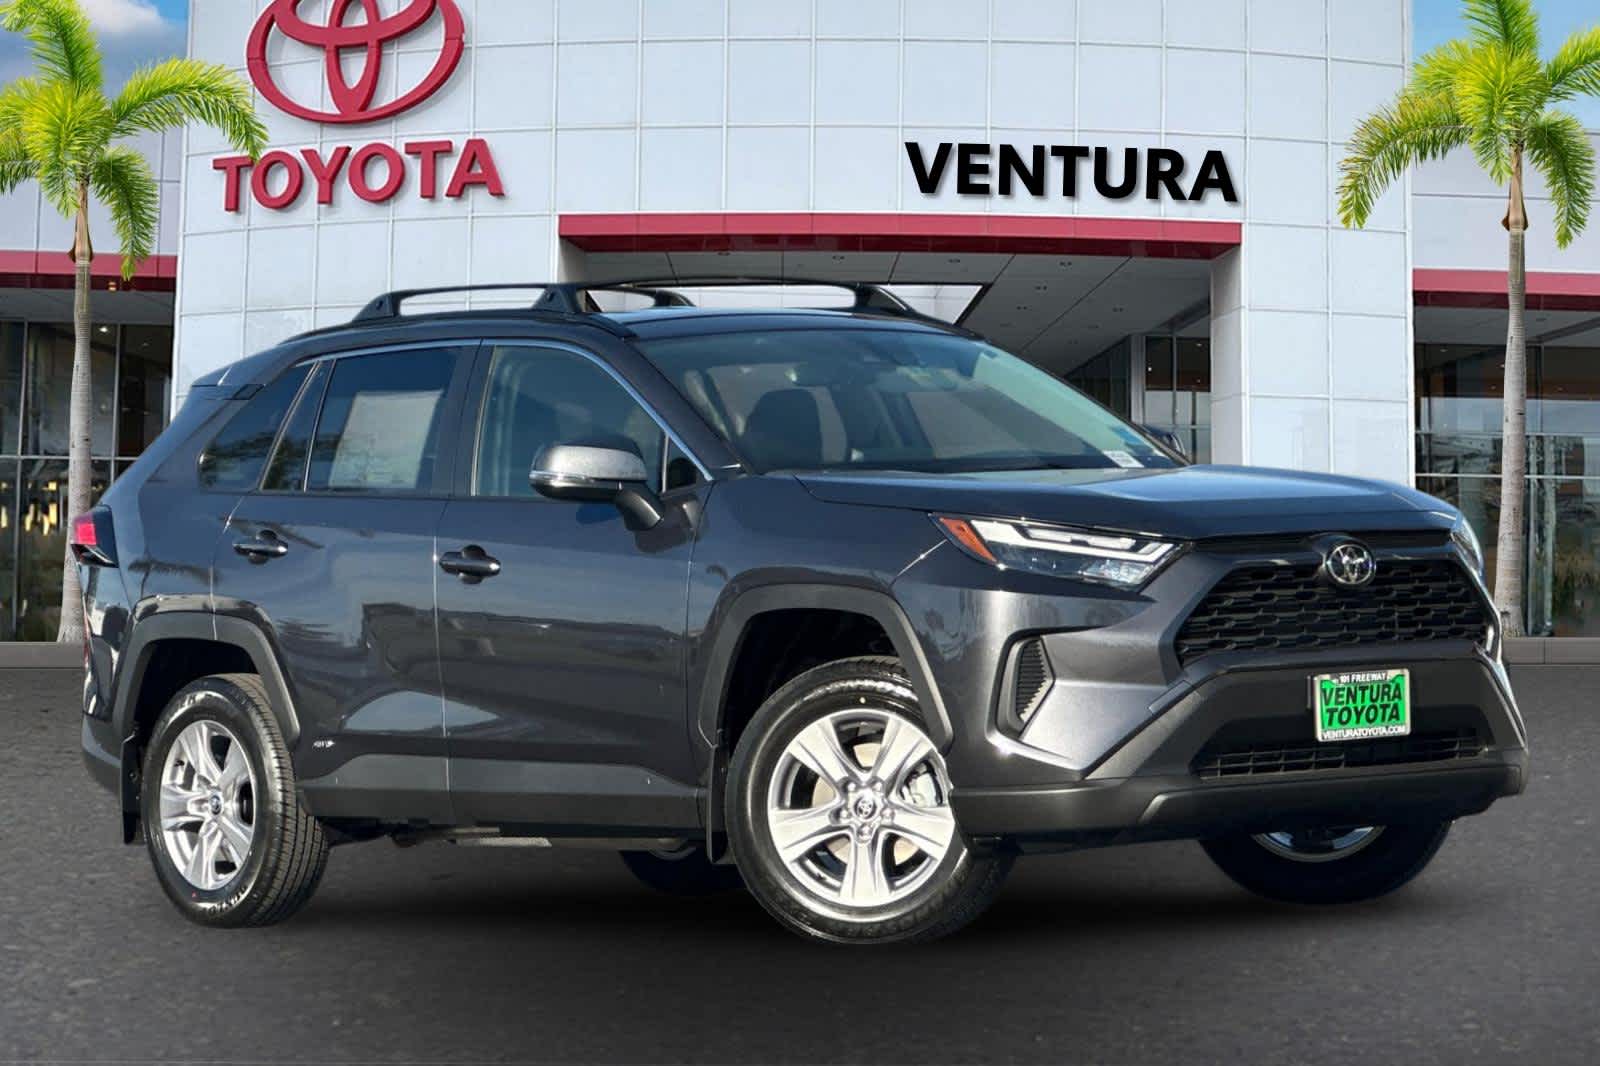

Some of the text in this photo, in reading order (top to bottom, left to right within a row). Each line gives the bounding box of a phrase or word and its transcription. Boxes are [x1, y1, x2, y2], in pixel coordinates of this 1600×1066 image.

[213, 138, 505, 212] TOYOTA
[905, 142, 1238, 202] VENTURA
[1351, 672, 1387, 682] FREEWAY
[1321, 683, 1402, 706] VENTURA
[1326, 703, 1400, 726] TOYOTA
[1323, 726, 1406, 739] VENTURATOYOTA.COM
